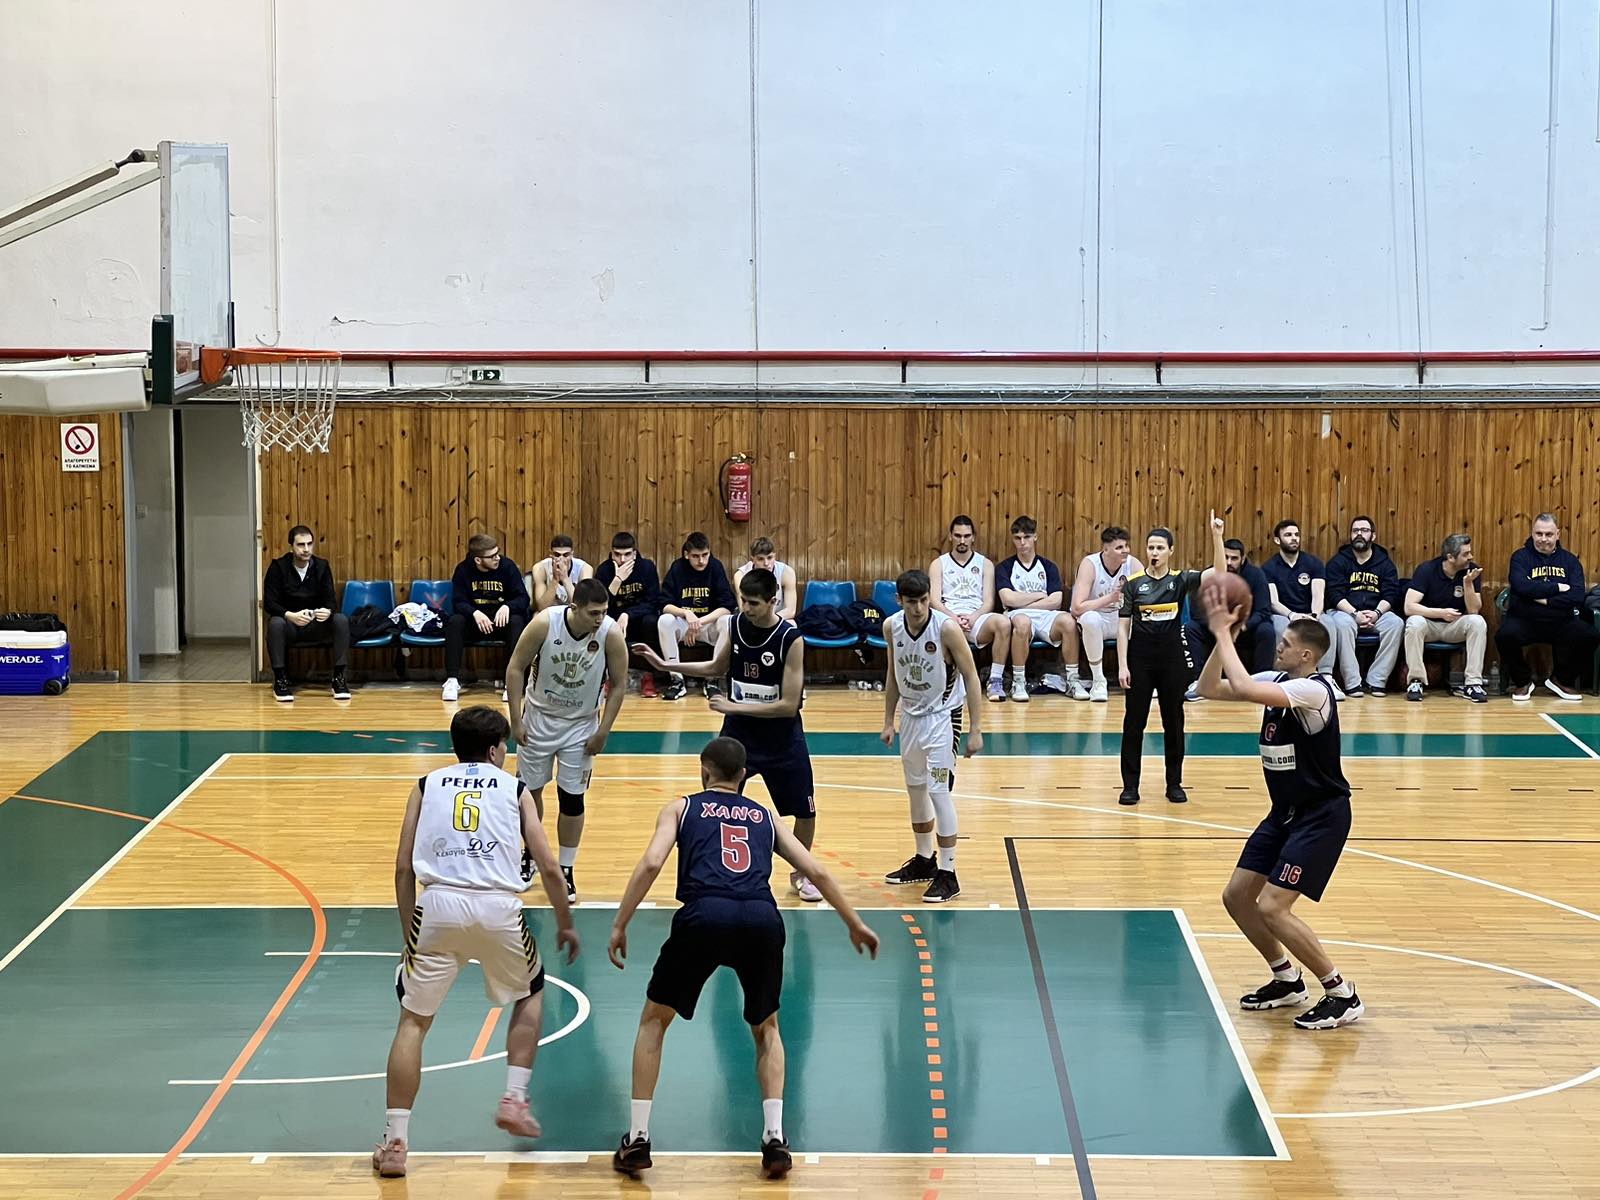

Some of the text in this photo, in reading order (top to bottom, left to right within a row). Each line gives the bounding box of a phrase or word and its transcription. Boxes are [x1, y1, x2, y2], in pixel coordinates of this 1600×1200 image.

[1349, 571, 1379, 585] MACITES
[743, 661, 760, 679] 13
[441, 777, 499, 789] PEFKA
[452, 790, 482, 833] 6
[720, 821, 751, 873] 5
[1278, 863, 1303, 885] 16
